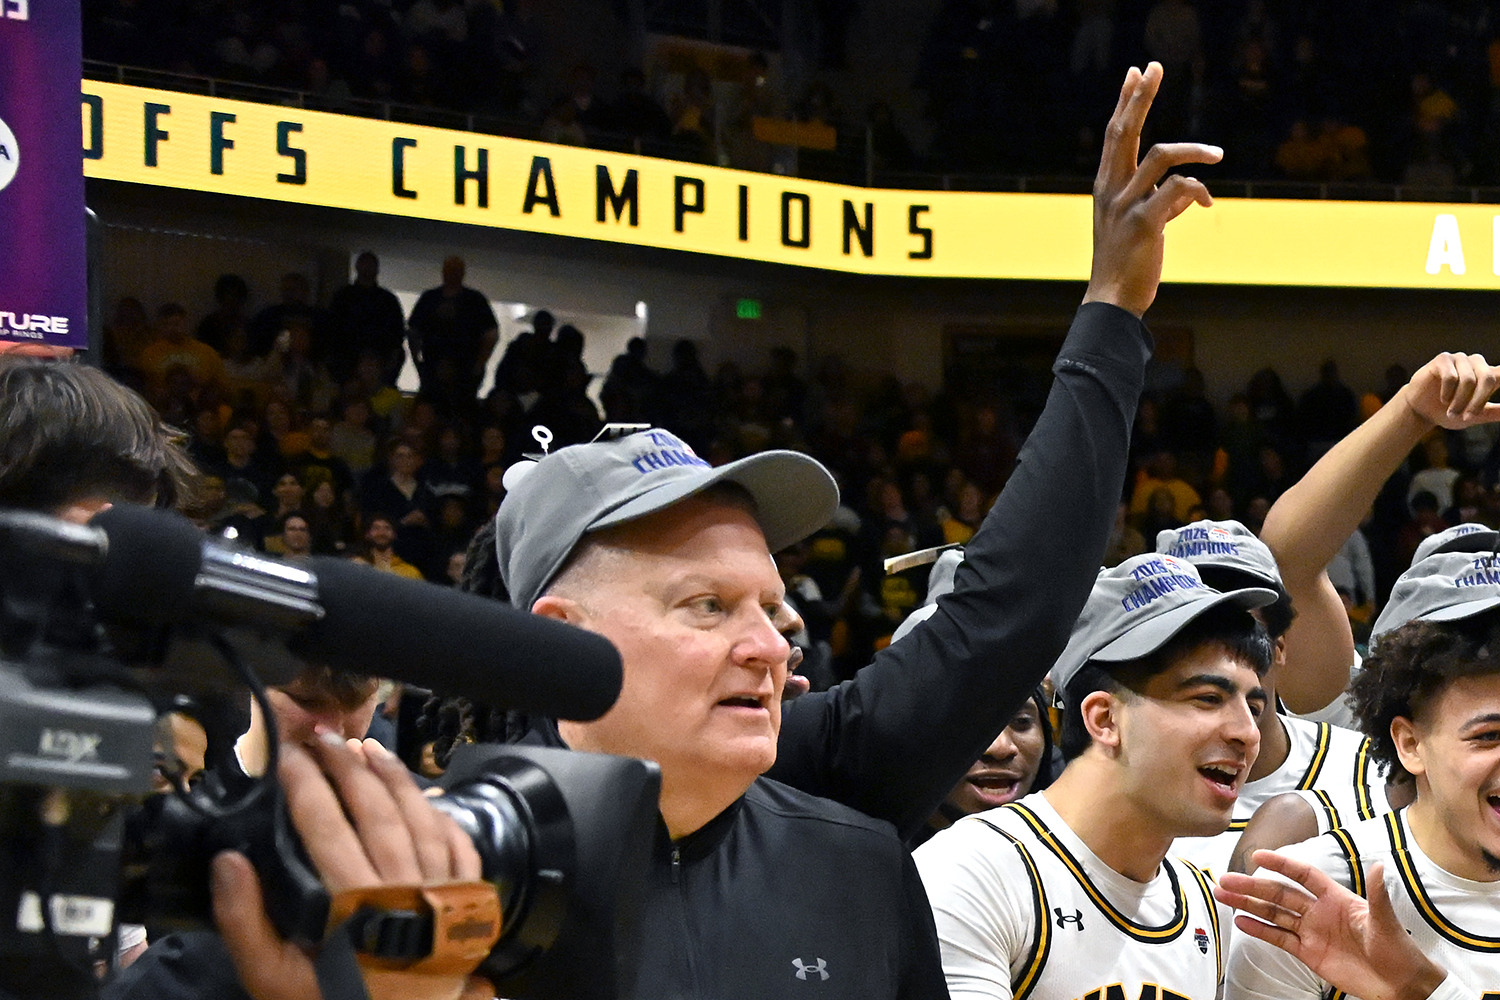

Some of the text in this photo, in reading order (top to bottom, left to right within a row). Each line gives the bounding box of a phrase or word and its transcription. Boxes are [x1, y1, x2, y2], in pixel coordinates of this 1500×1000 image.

[392, 137, 934, 260] CHAMPIONS
[1178, 527, 1209, 543] 2026
[1129, 560, 1168, 582] 2026
